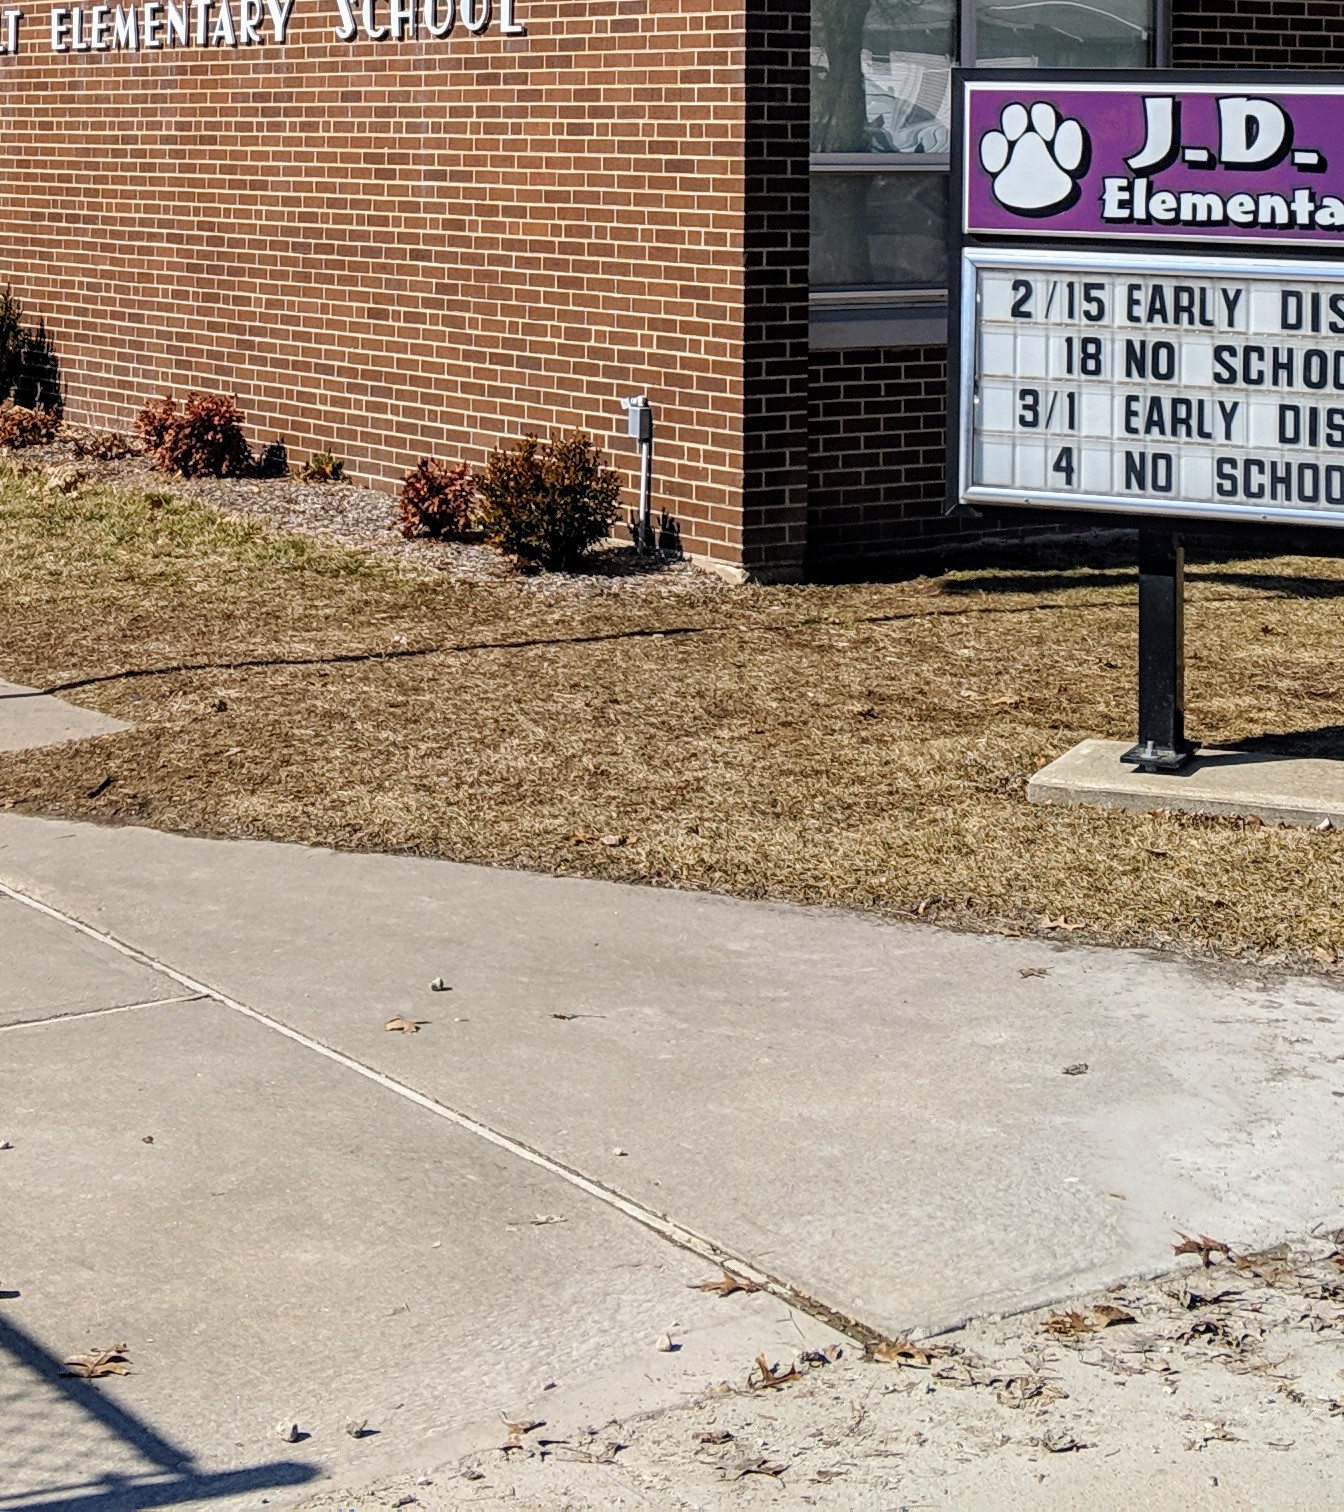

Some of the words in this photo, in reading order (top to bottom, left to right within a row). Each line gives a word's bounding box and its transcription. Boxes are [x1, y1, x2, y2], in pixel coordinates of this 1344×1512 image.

[1125, 96, 1323, 172] J.D.
[1011, 279, 1106, 322] 2/15
[1126, 283, 1243, 328] EARLY
[1065, 337, 1102, 376] 18
[1126, 341, 1176, 380] NO
[1018, 389, 1077, 430] 3/1
[1125, 393, 1239, 440] EARLY
[1052, 447, 1074, 485] 4
[1126, 452, 1172, 492] NO
